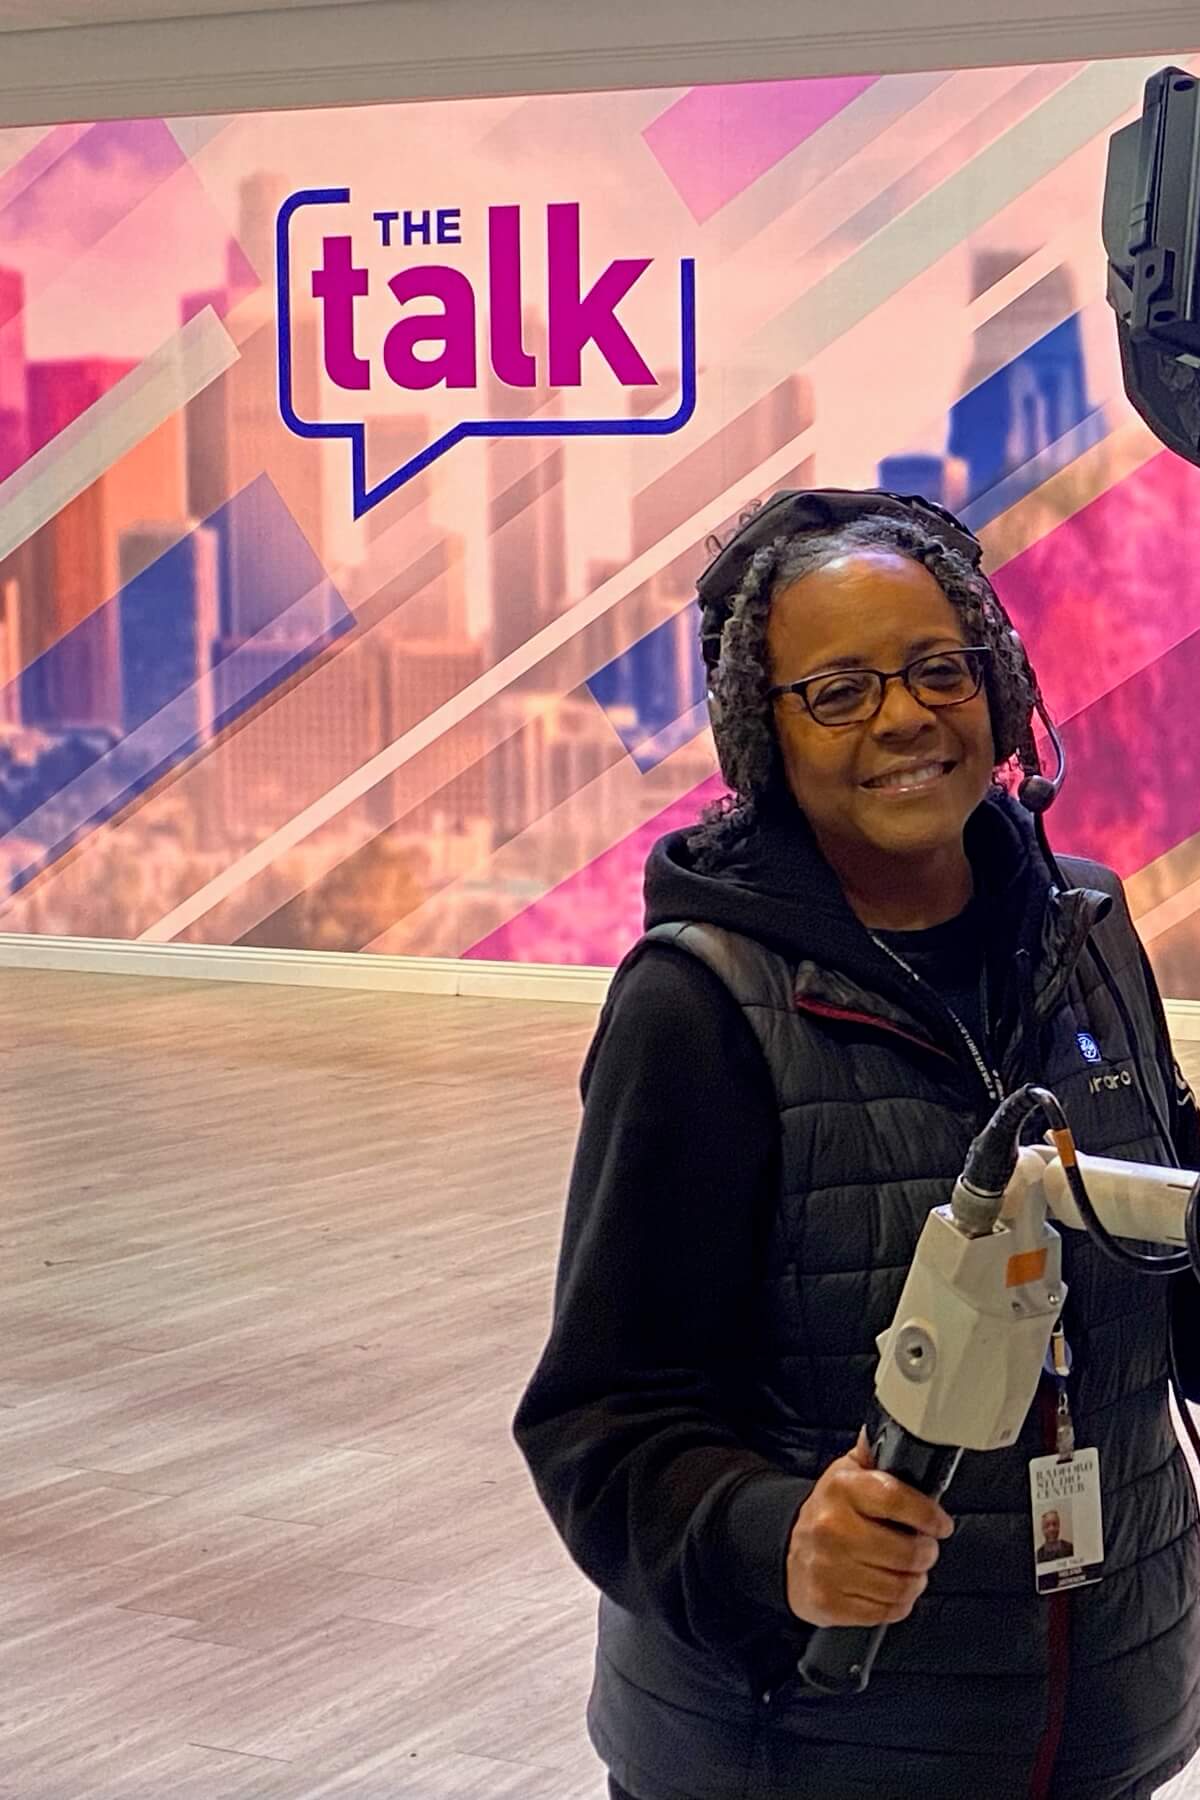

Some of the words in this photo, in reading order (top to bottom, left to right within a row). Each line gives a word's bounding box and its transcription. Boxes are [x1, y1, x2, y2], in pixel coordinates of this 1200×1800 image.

[373, 208, 462, 246] THE
[311, 202, 660, 391] talk
[1036, 1484, 1086, 1500] CENTER
